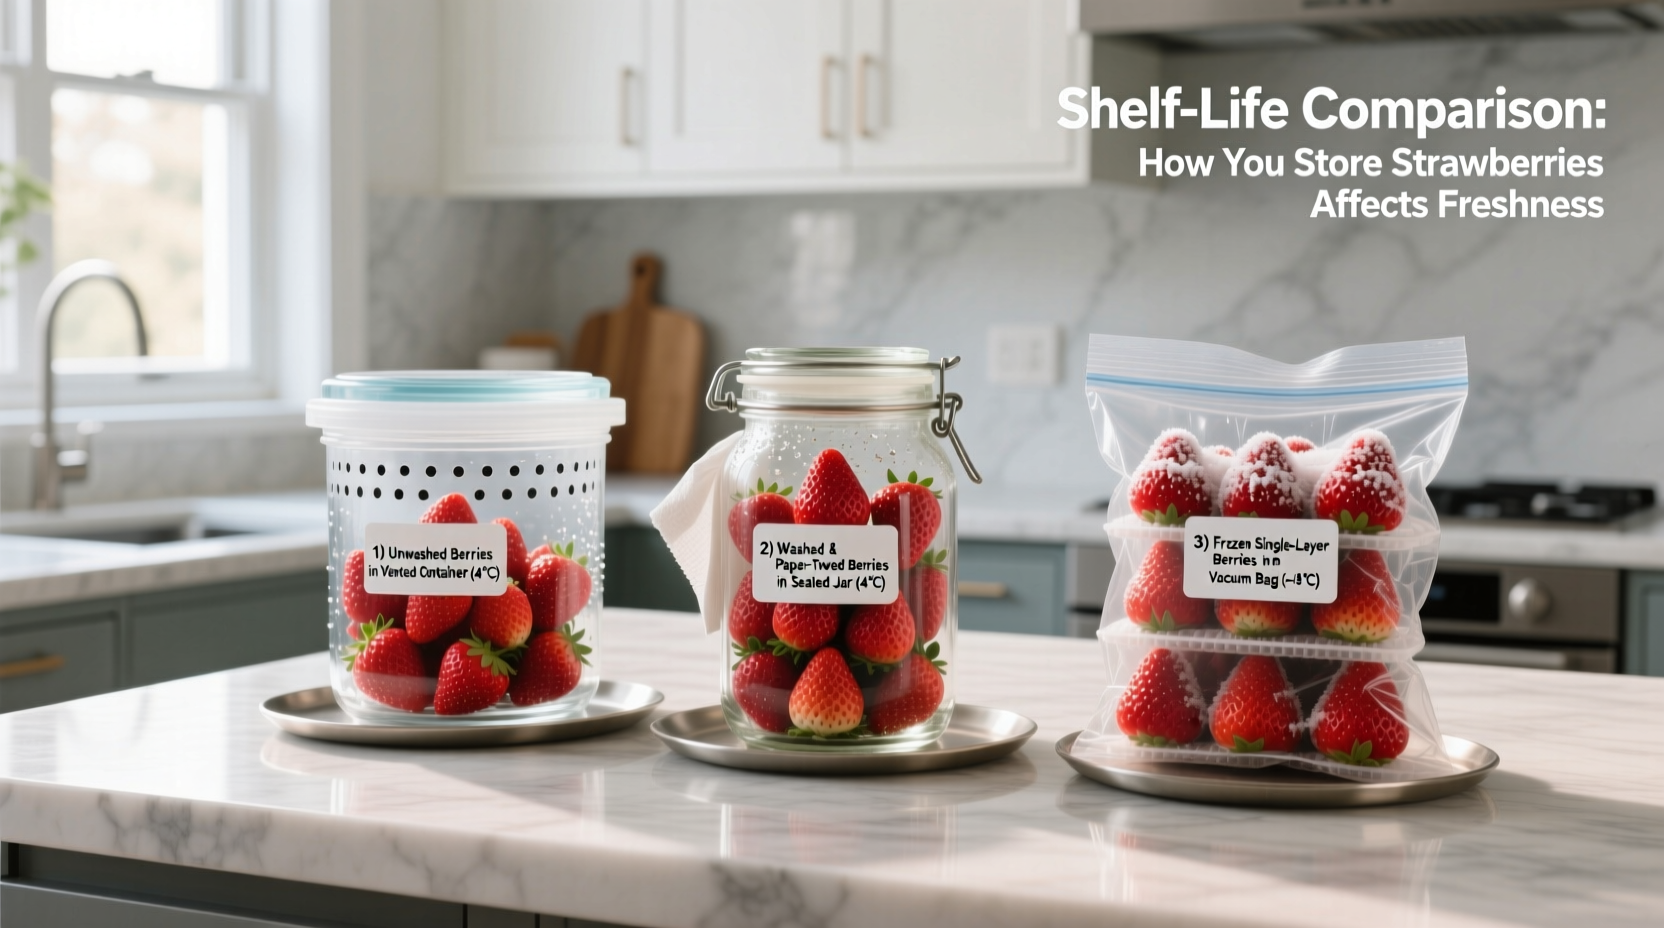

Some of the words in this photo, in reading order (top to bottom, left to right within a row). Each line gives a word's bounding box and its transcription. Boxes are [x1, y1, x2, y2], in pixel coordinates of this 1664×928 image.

[372, 544, 385, 560] 1)
[451, 547, 493, 560] Berries
[760, 541, 774, 558] 2)
[829, 542, 837, 555] &
[1194, 534, 1209, 552] 3)
[1255, 537, 1329, 556] Single-Layer
[848, 558, 889, 571] Berries
[1213, 553, 1257, 566] Berries
[368, 565, 378, 577] in
[777, 575, 787, 588] in
[791, 576, 830, 588] Sealed
[833, 576, 853, 589] Jar
[1209, 571, 1251, 584] Vacuum
[1255, 572, 1279, 589] Bag
